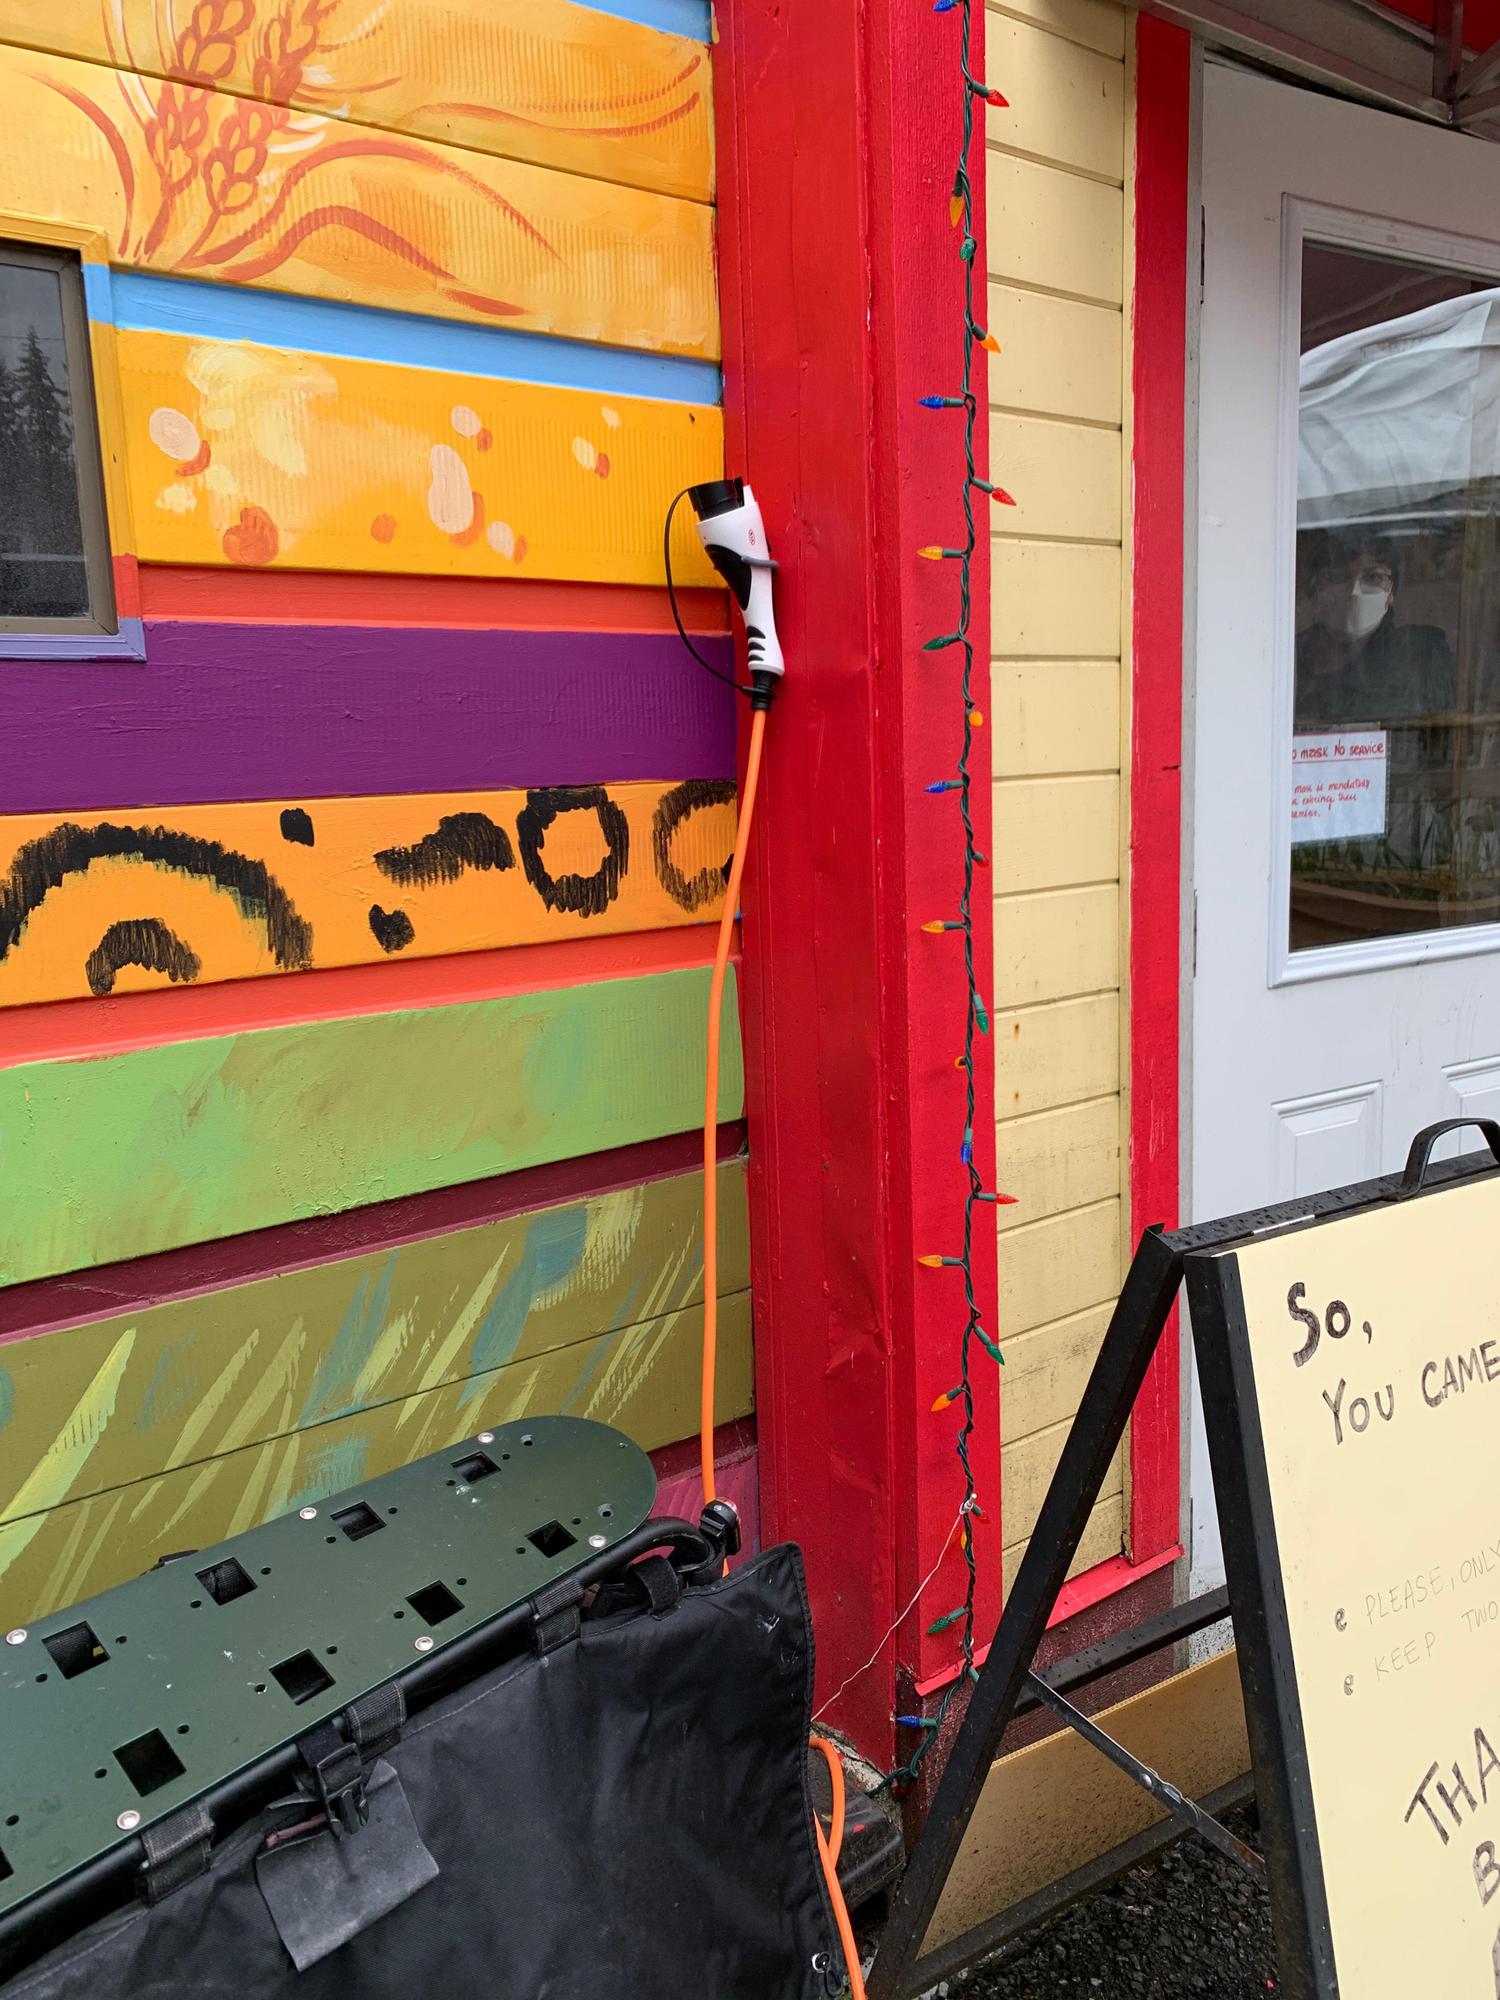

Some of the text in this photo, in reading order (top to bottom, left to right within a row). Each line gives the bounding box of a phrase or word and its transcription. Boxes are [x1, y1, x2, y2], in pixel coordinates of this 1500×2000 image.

[1287, 1281, 1373, 1368] So,
[1322, 1339, 1500, 1446] YOU CAME
[1374, 1600, 1499, 1682] KEEP TWO
